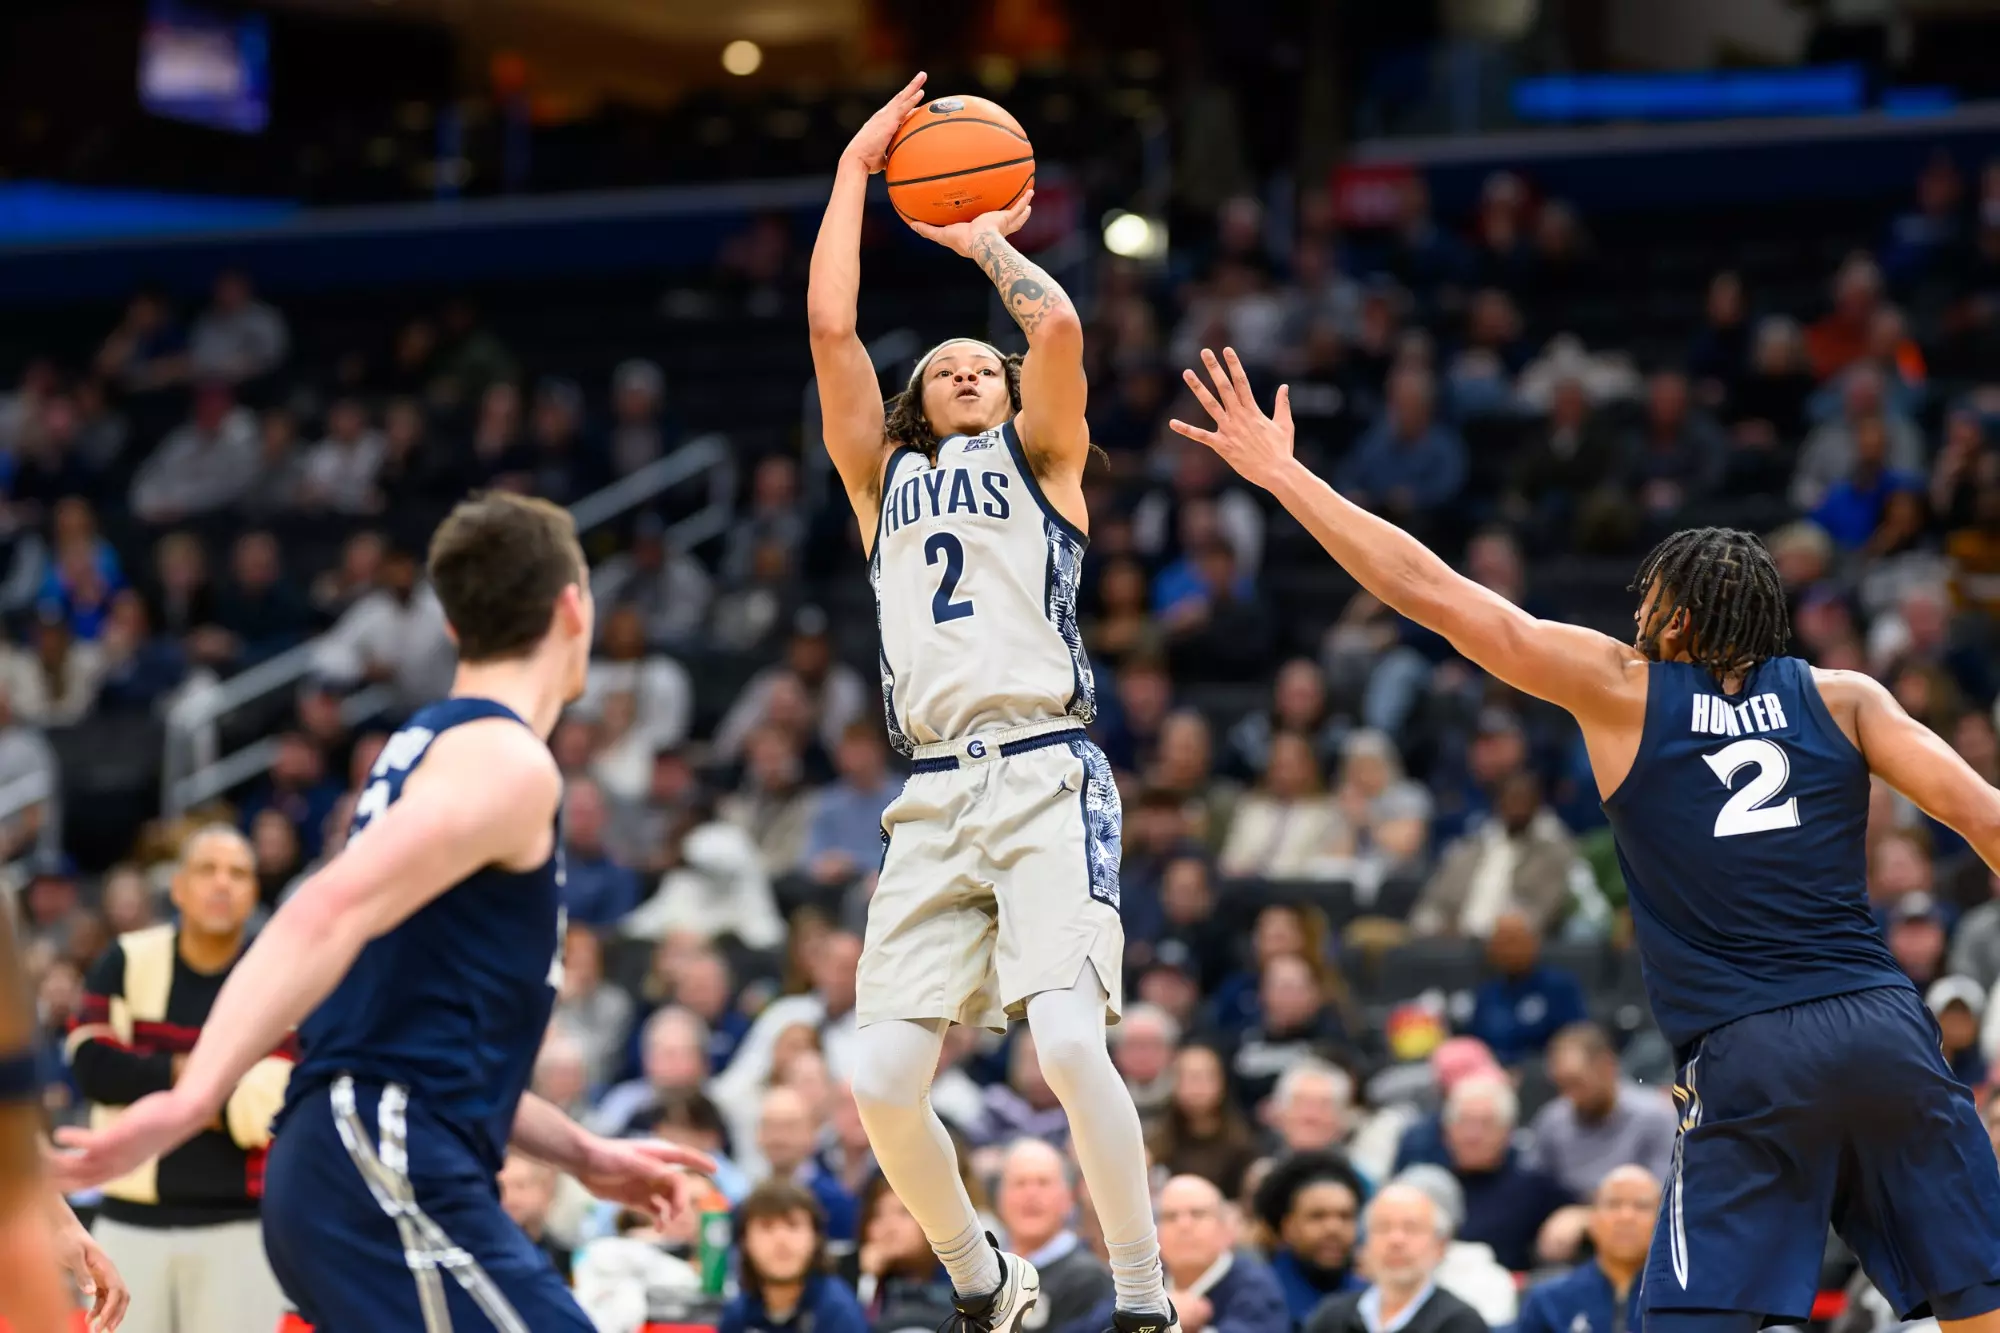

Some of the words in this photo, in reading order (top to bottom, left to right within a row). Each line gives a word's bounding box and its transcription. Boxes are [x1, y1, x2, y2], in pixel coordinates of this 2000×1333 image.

[962, 443, 995, 452] EAST
[885, 467, 1011, 539] HOYAS
[923, 531, 975, 625] 2
[1690, 693, 1788, 737] HUNTER
[966, 740, 987, 759] G
[1701, 737, 1801, 838] 2
